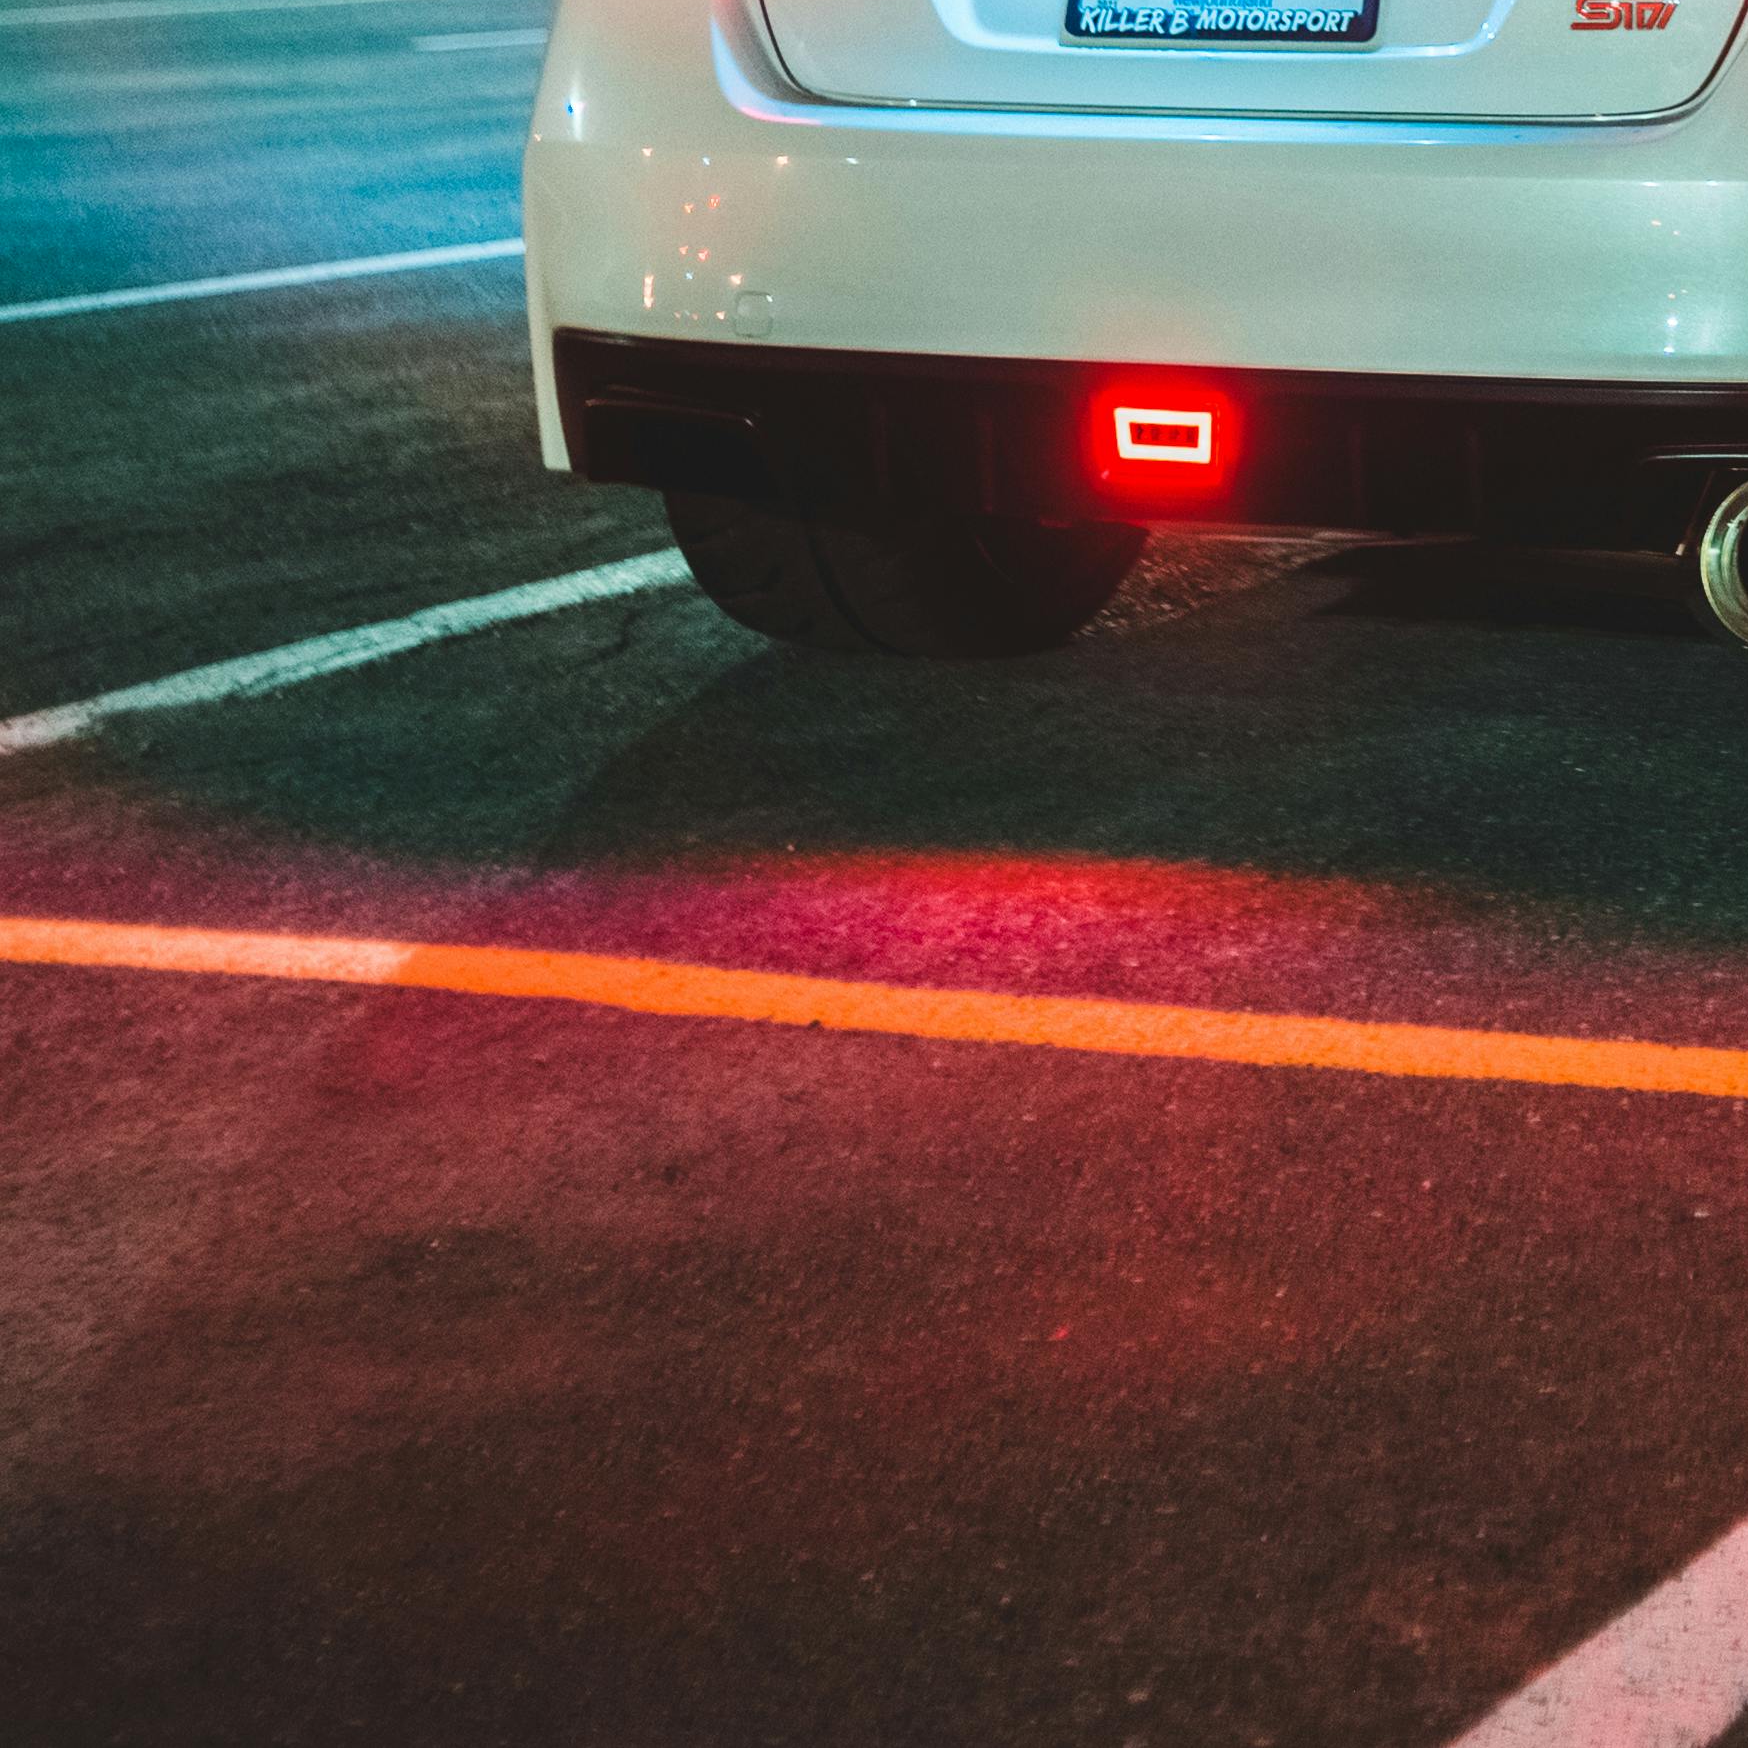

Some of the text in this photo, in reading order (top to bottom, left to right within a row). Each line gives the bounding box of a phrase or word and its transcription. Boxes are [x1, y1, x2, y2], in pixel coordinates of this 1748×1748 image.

[1080, 7, 1354, 36] KILLER B MOTORSPORT
